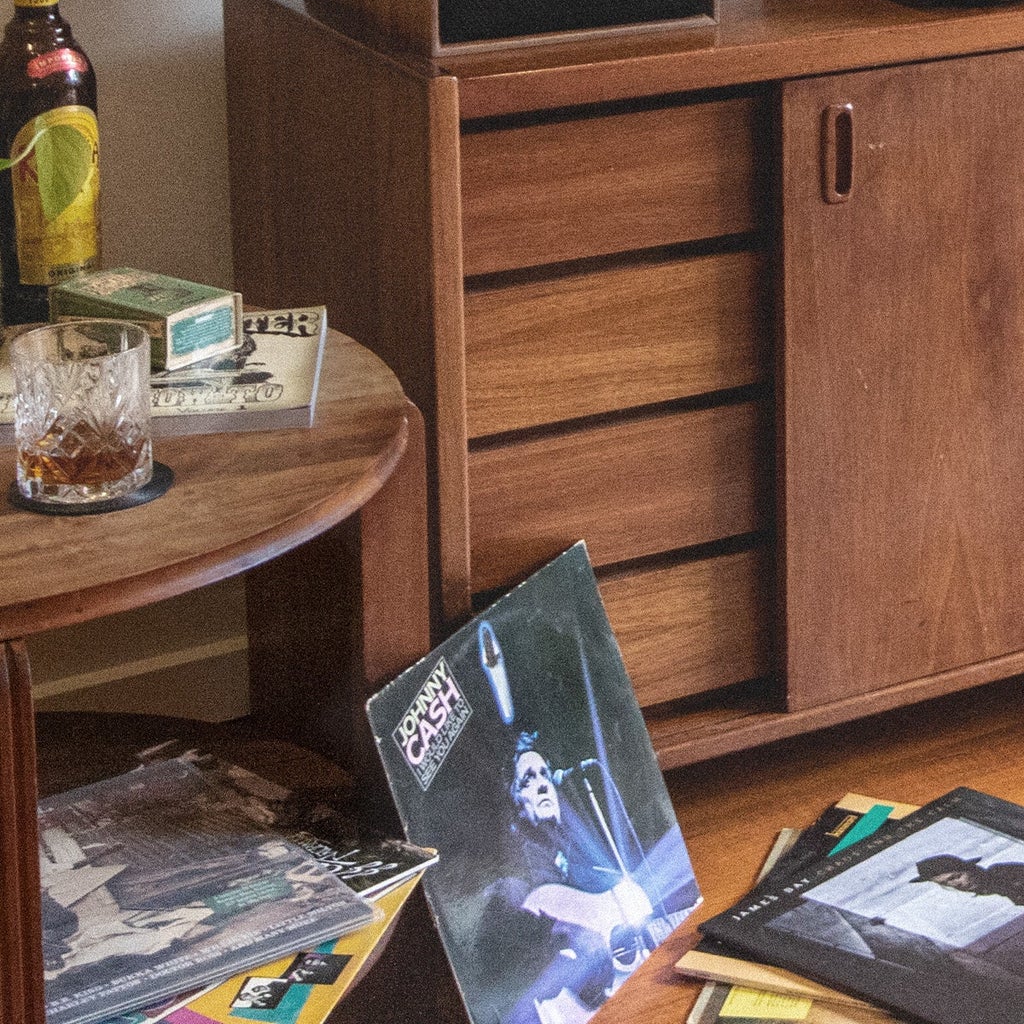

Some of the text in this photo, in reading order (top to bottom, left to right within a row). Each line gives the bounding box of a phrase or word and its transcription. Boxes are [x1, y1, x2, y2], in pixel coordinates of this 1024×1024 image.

[398, 661, 447, 747] JOHNNY
[406, 676, 461, 765] CASH
[419, 734, 442, 770] WOULD
[453, 697, 465, 713] TO
[421, 707, 470, 786] SEE YOU AGAIN
[732, 877, 810, 921] JAMES BAY
